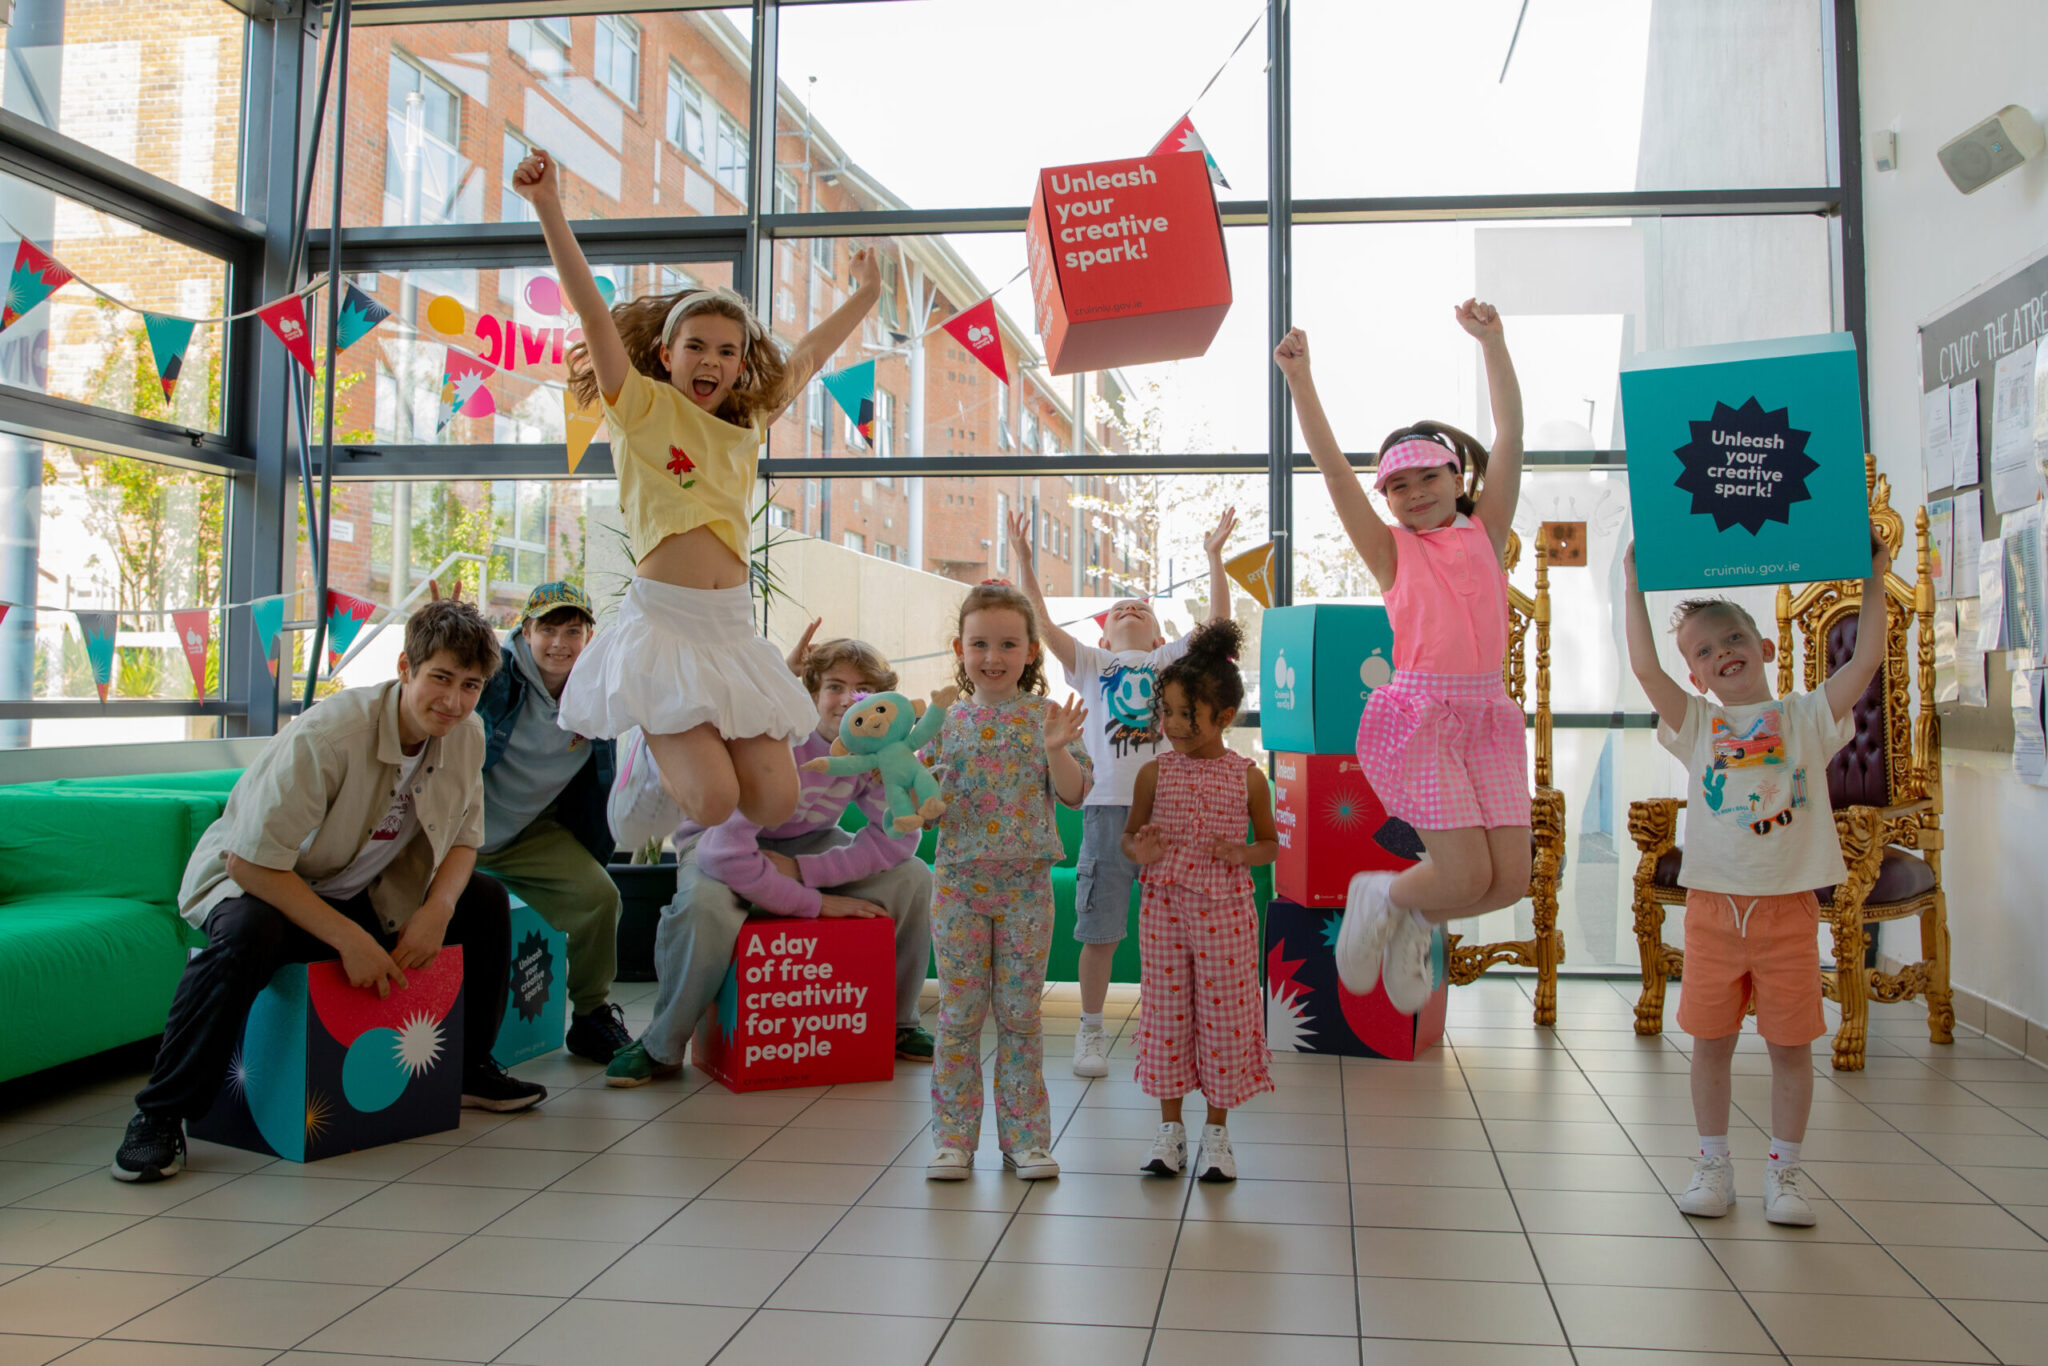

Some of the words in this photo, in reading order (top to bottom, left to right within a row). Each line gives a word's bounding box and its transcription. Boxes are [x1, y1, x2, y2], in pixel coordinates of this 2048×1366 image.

[1051, 164, 1157, 194] Unleash
[1055, 198, 1114, 224] your
[1060, 214, 1168, 243] creative
[1065, 237, 1148, 272] spark!
[1940, 331, 1980, 383] CIVIC
[1983, 291, 2048, 361] THEATRE
[1711, 430, 1784, 449] Unleash
[1725, 451, 1767, 466] your
[1707, 466, 1783, 482] creative
[1714, 482, 1773, 498] spark!
[1703, 561, 1801, 577] cruinniu.gov.ie
[1277, 828, 1291, 849] park!
[745, 934, 766, 957] A
[770, 932, 818, 960] day
[518, 947, 543, 971] Unleash
[746, 959, 775, 983] of
[779, 958, 833, 982] free
[520, 970, 545, 993] creative
[524, 963, 539, 980] your
[524, 980, 544, 1002] spark!
[745, 982, 868, 1009] creativity
[745, 1012, 787, 1036] for
[791, 1012, 867, 1038] young
[745, 1035, 832, 1068] people
